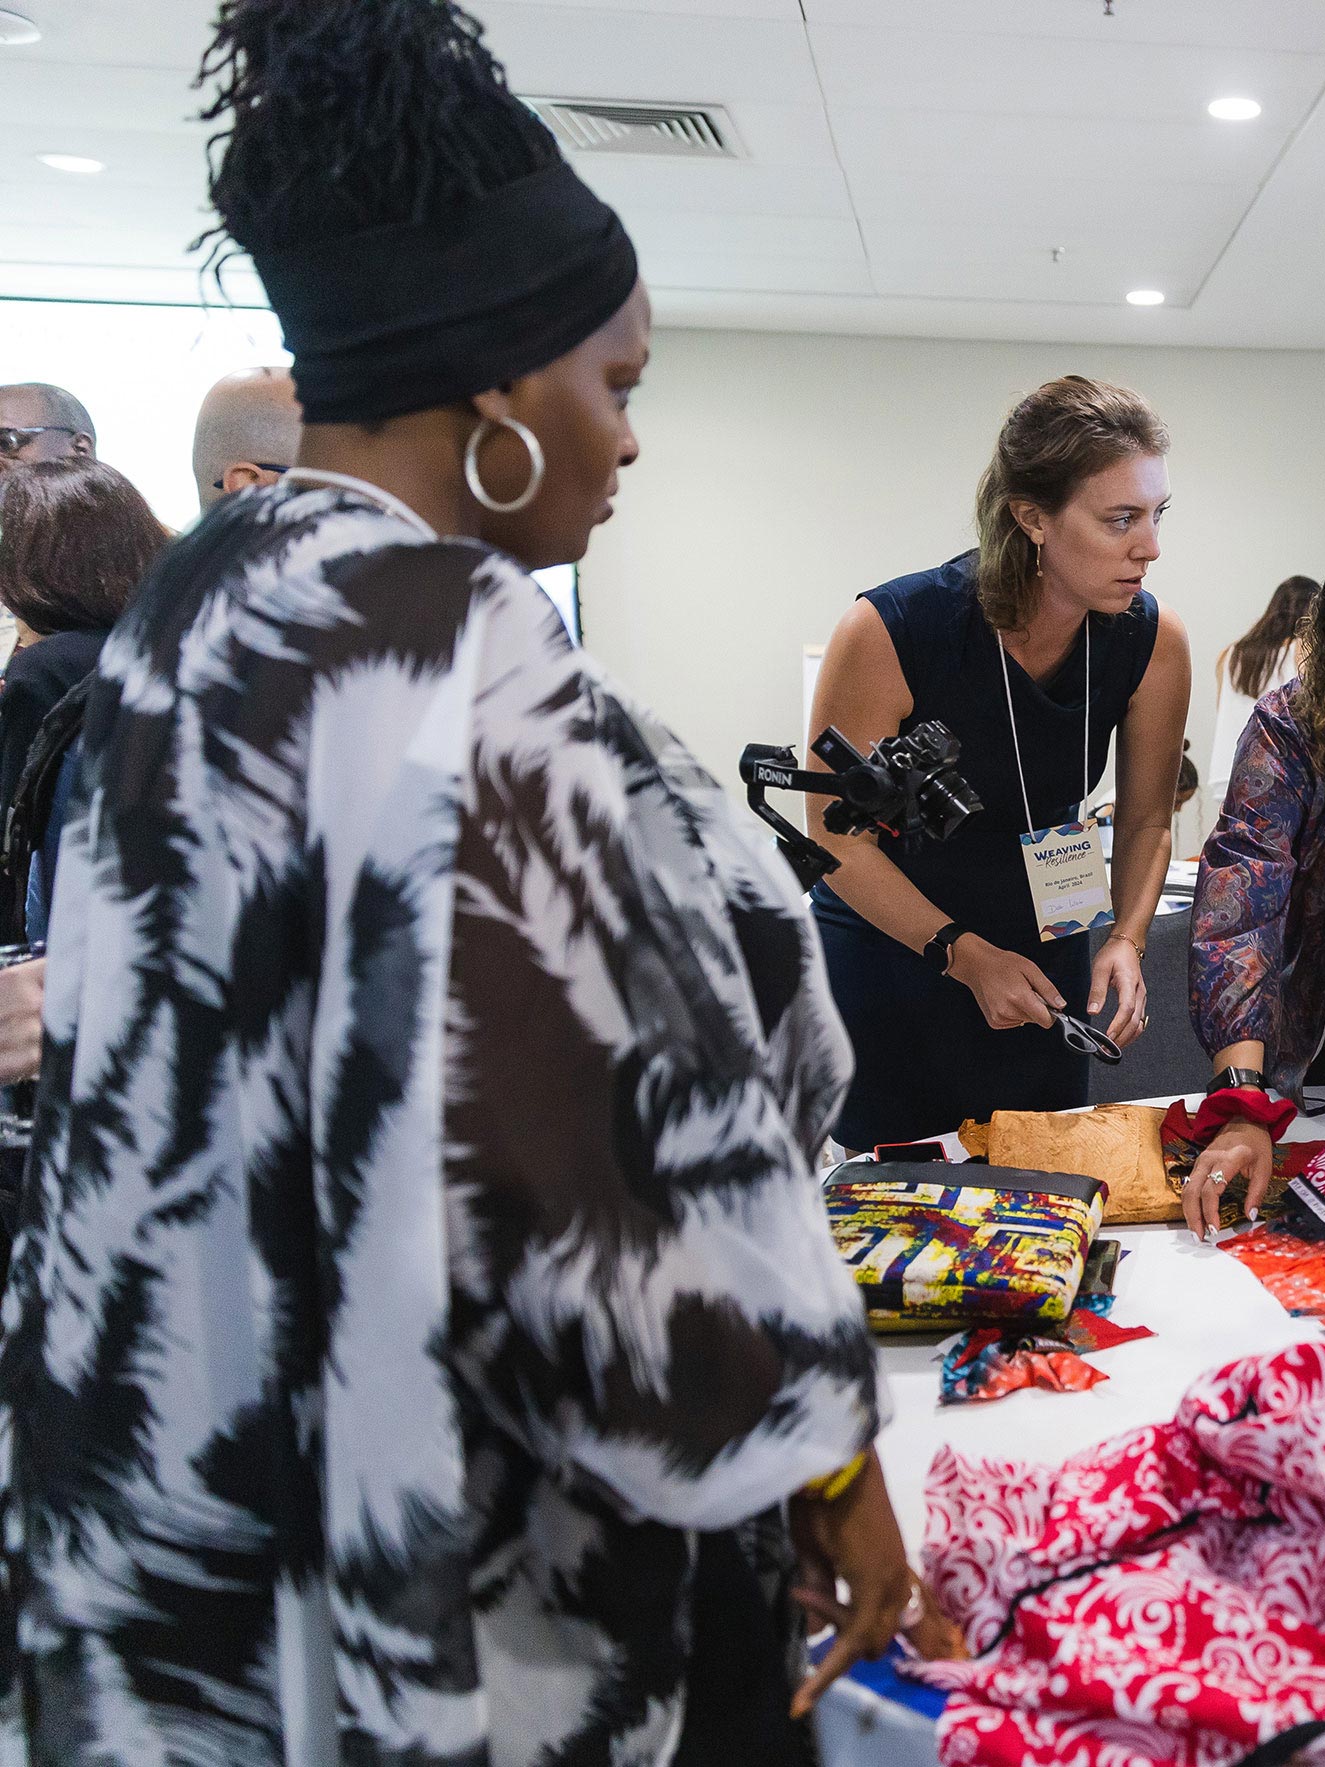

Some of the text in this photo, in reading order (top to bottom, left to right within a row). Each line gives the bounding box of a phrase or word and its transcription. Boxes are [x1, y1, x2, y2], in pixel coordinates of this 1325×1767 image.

[758, 767, 792, 786] RONIN
[1034, 841, 1091, 861] WEAVING
[1045, 851, 1087, 869] Resilience
